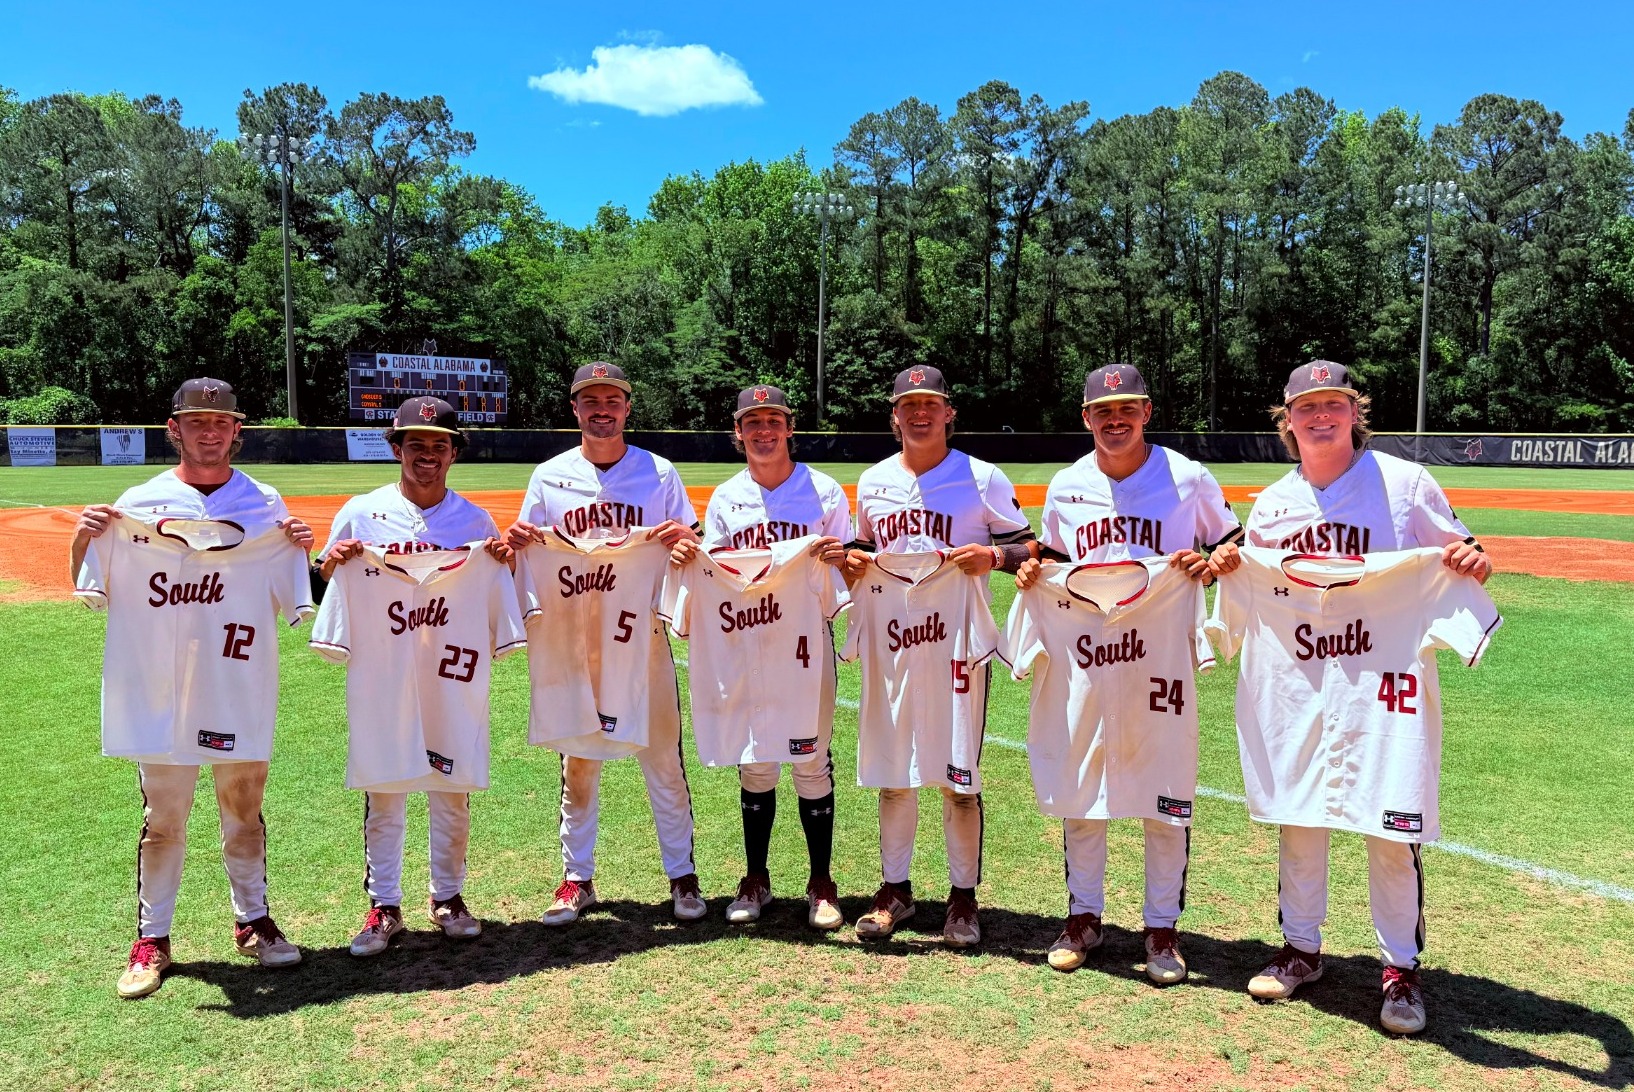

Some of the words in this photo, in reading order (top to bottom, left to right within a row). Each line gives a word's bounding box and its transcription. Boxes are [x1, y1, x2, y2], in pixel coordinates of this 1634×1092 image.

[392, 356, 431, 370] COASTAL
[433, 358, 476, 373] ALABAMA
[457, 412, 484, 422] FIELD
[1510, 440, 1584, 462] COASTAL
[877, 509, 955, 549] COASTAL
[1076, 516, 1165, 561] COASTAL
[148, 571, 225, 608] South
[558, 563, 617, 599] South
[387, 596, 449, 636] South
[613, 609, 637, 644] 5
[719, 592, 783, 634] South
[887, 611, 947, 653] South
[222, 622, 256, 662] 12
[796, 635, 811, 669] 4
[1076, 628, 1147, 670] South
[1294, 618, 1373, 661] South
[438, 644, 479, 683] 23
[1149, 676, 1185, 716] 24
[1377, 671, 1418, 715] 42
